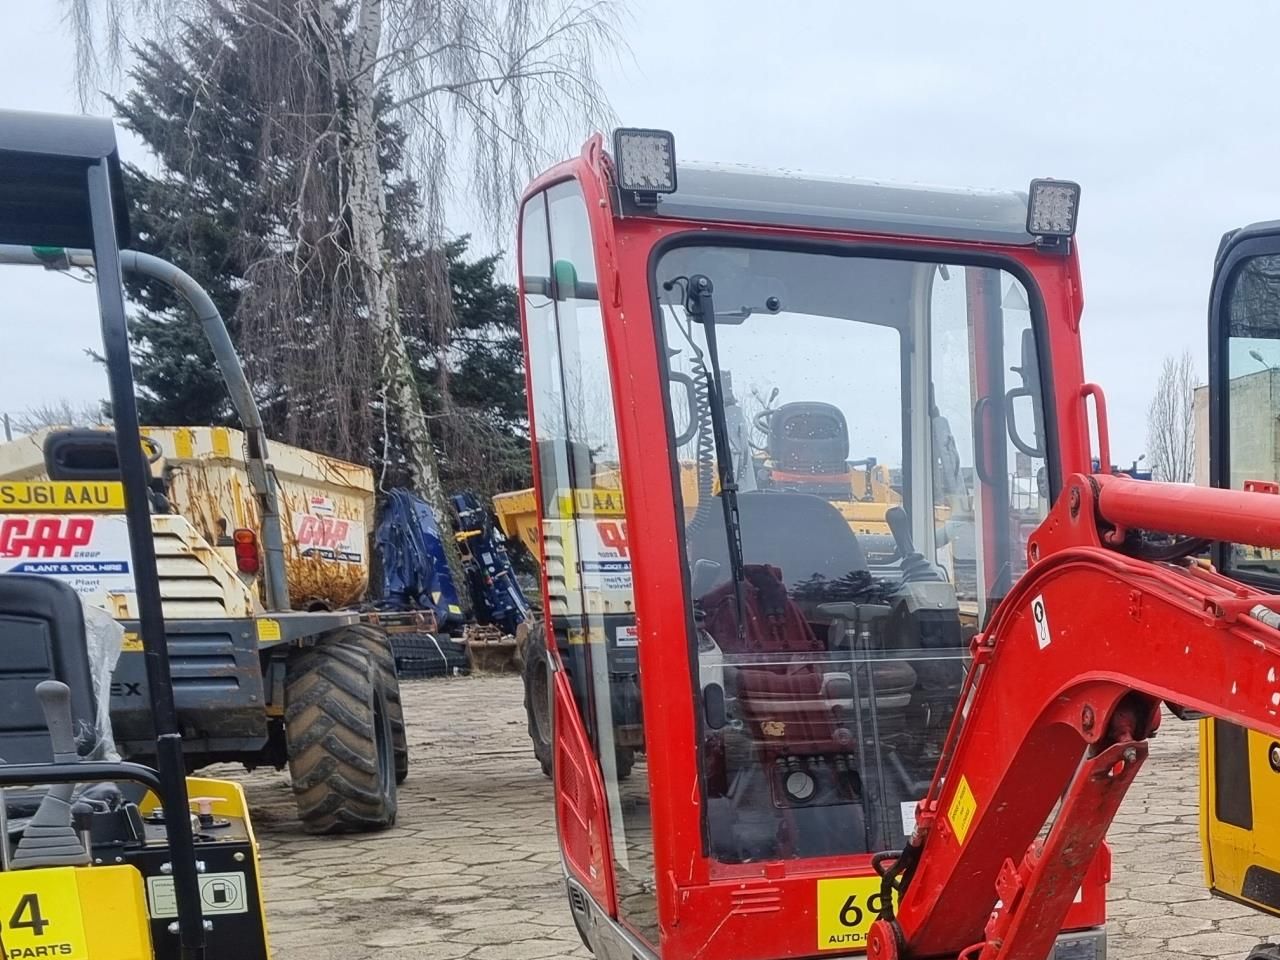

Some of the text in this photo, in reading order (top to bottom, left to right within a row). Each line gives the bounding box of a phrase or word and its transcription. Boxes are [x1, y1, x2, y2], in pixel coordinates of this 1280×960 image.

[64, 486, 109, 504] AAU
[0, 518, 94, 557] GAP
[24, 563, 60, 572] PLANT
[70, 563, 98, 572] TOOL
[98, 563, 123, 571] HIRE
[0, 892, 49, 937] 4
[829, 933, 867, 943] AUTO-
